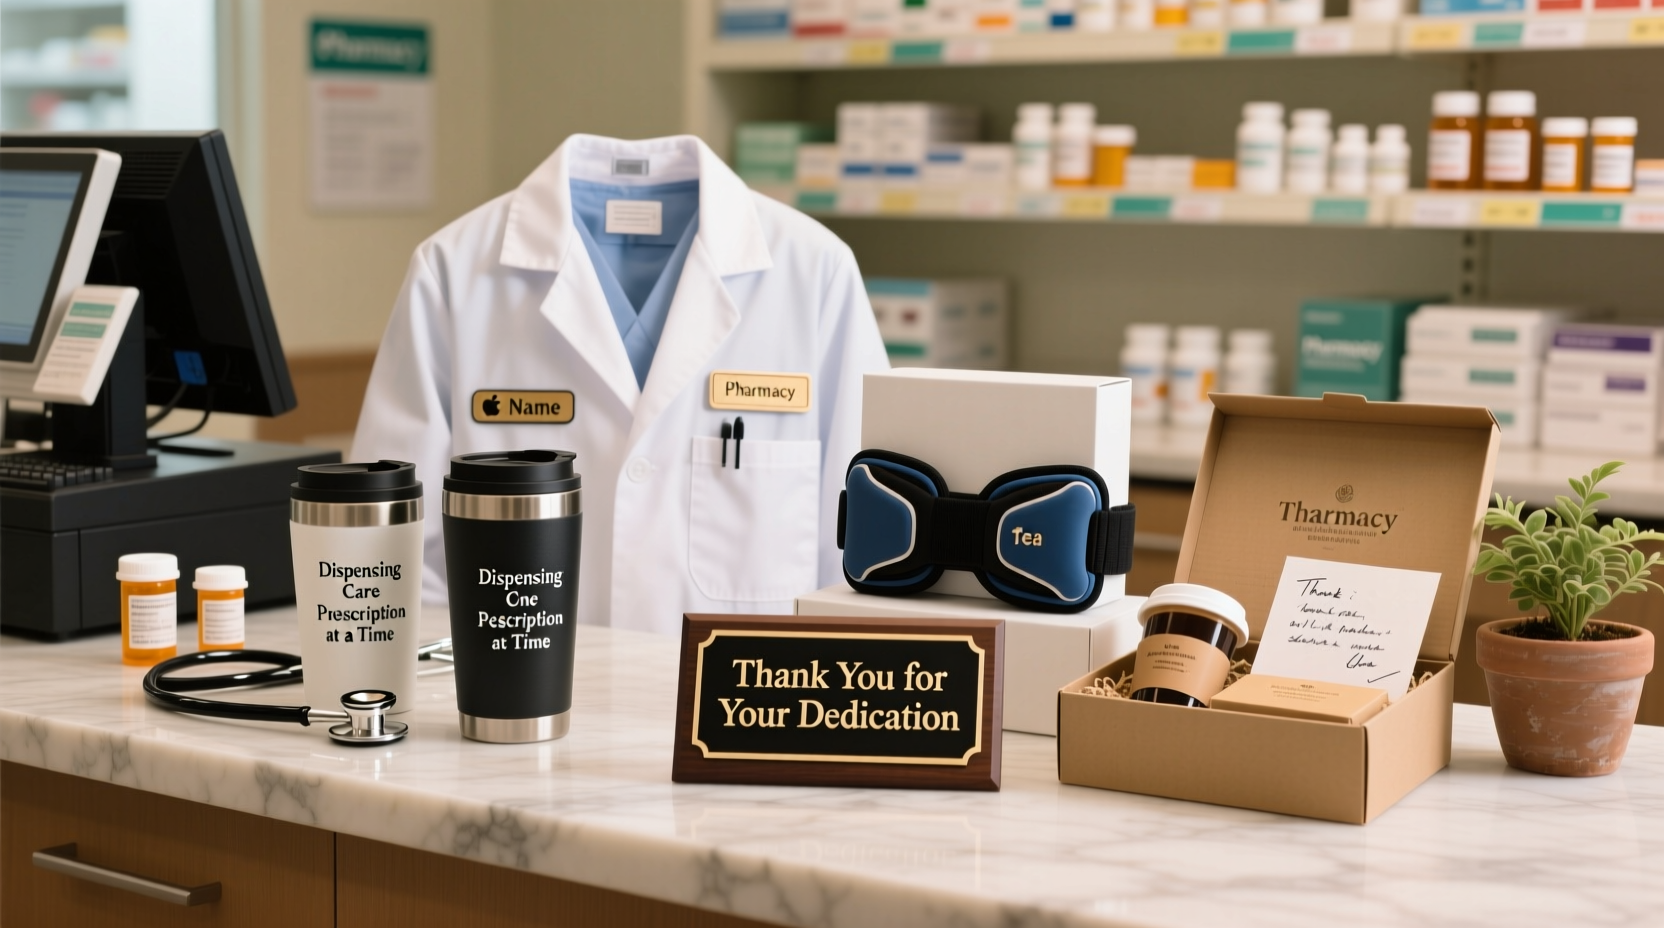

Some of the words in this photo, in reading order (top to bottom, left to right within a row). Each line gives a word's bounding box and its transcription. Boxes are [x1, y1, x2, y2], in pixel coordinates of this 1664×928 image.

[725, 381, 796, 402] Pharmacy
[509, 398, 561, 416] Name
[1279, 500, 1398, 535] Tharmacy
[1011, 526, 1042, 547] Tea
[319, 561, 402, 582] Dispensing
[478, 568, 563, 590] Dispensing
[342, 583, 380, 599] Care
[317, 604, 406, 624] Prescription
[326, 629, 339, 642] at
[344, 631, 354, 642] a
[356, 626, 394, 642] Time
[492, 637, 507, 650] at
[511, 633, 551, 650] Time
[732, 659, 830, 689] Thank
[836, 661, 895, 691] You
[904, 661, 948, 692] for
[718, 698, 790, 728] Your
[797, 699, 960, 731] Dedication
